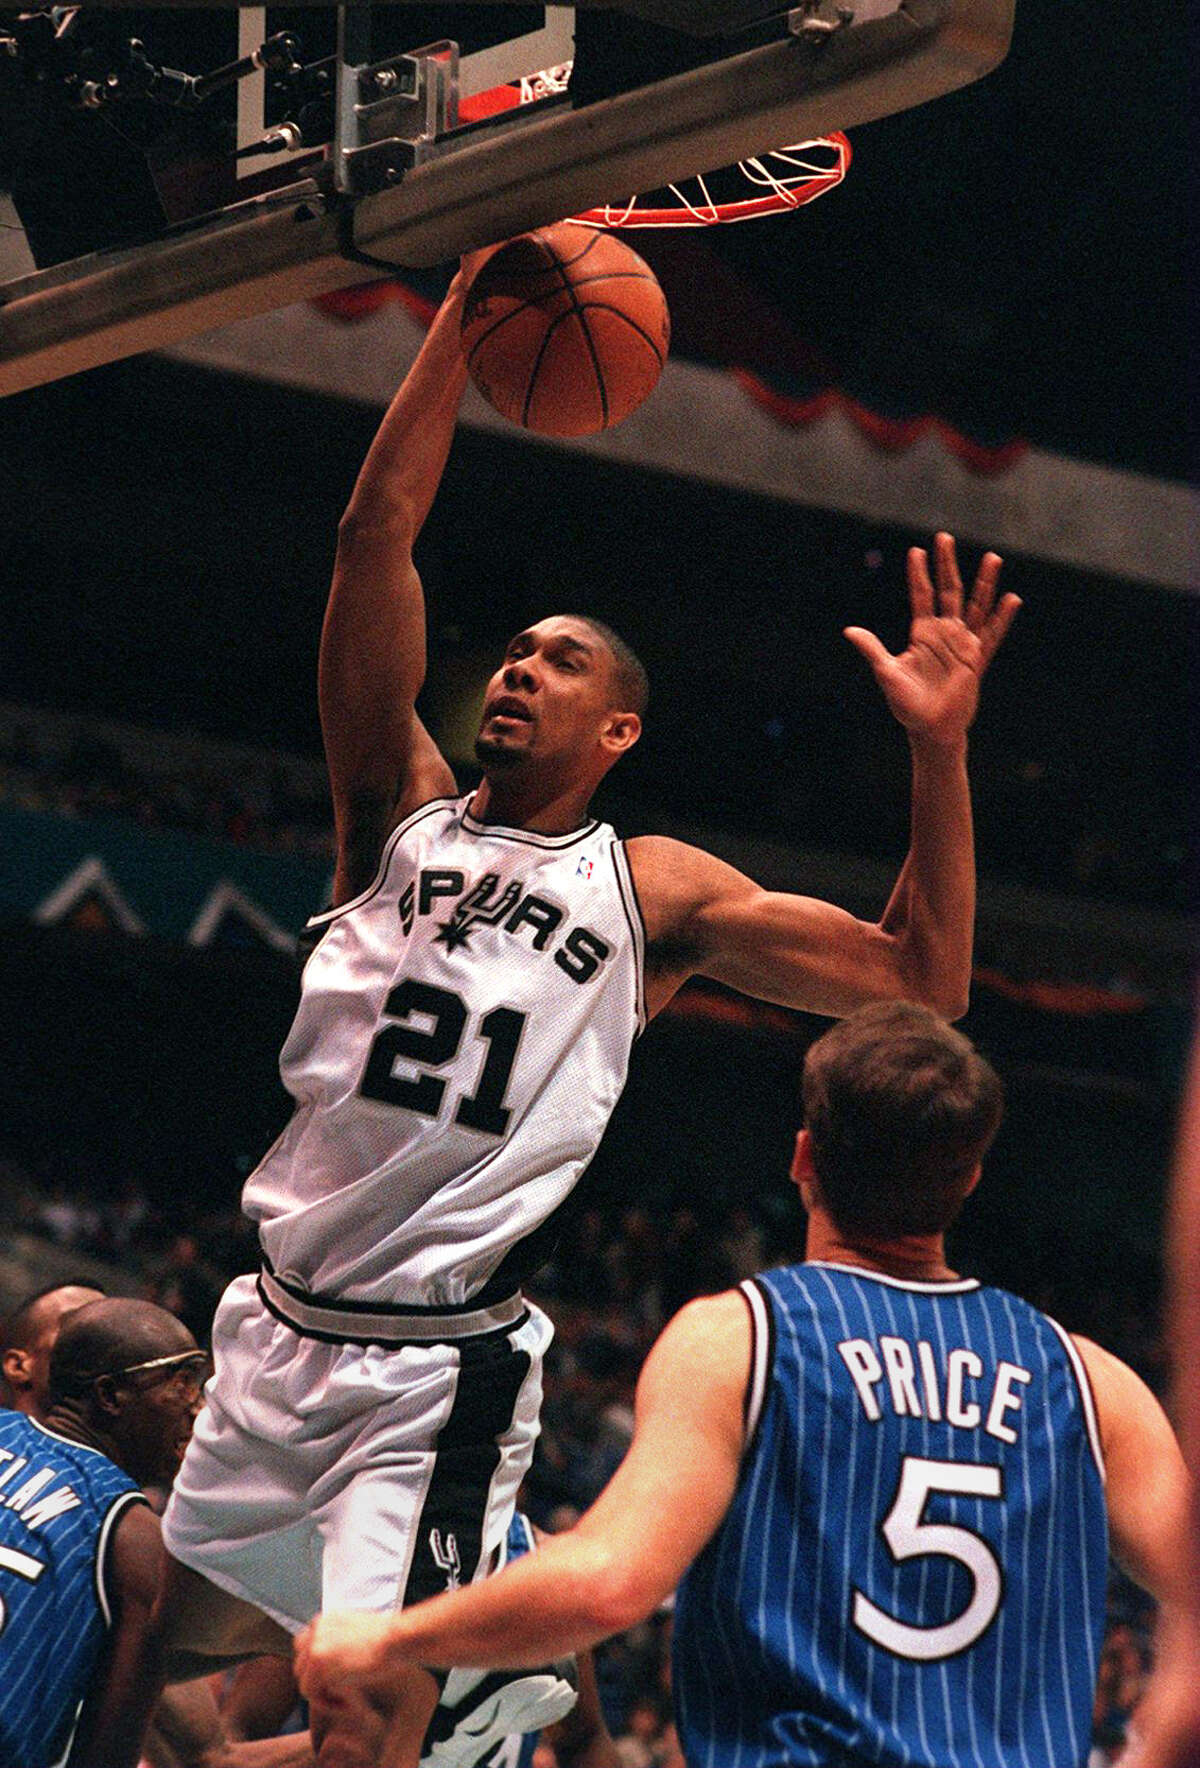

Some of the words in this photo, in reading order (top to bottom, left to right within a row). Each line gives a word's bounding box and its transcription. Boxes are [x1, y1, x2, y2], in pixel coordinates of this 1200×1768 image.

[358, 976, 531, 1138] 21
[837, 1335, 1033, 1446] PRICE
[852, 1454, 1002, 1661] 5
